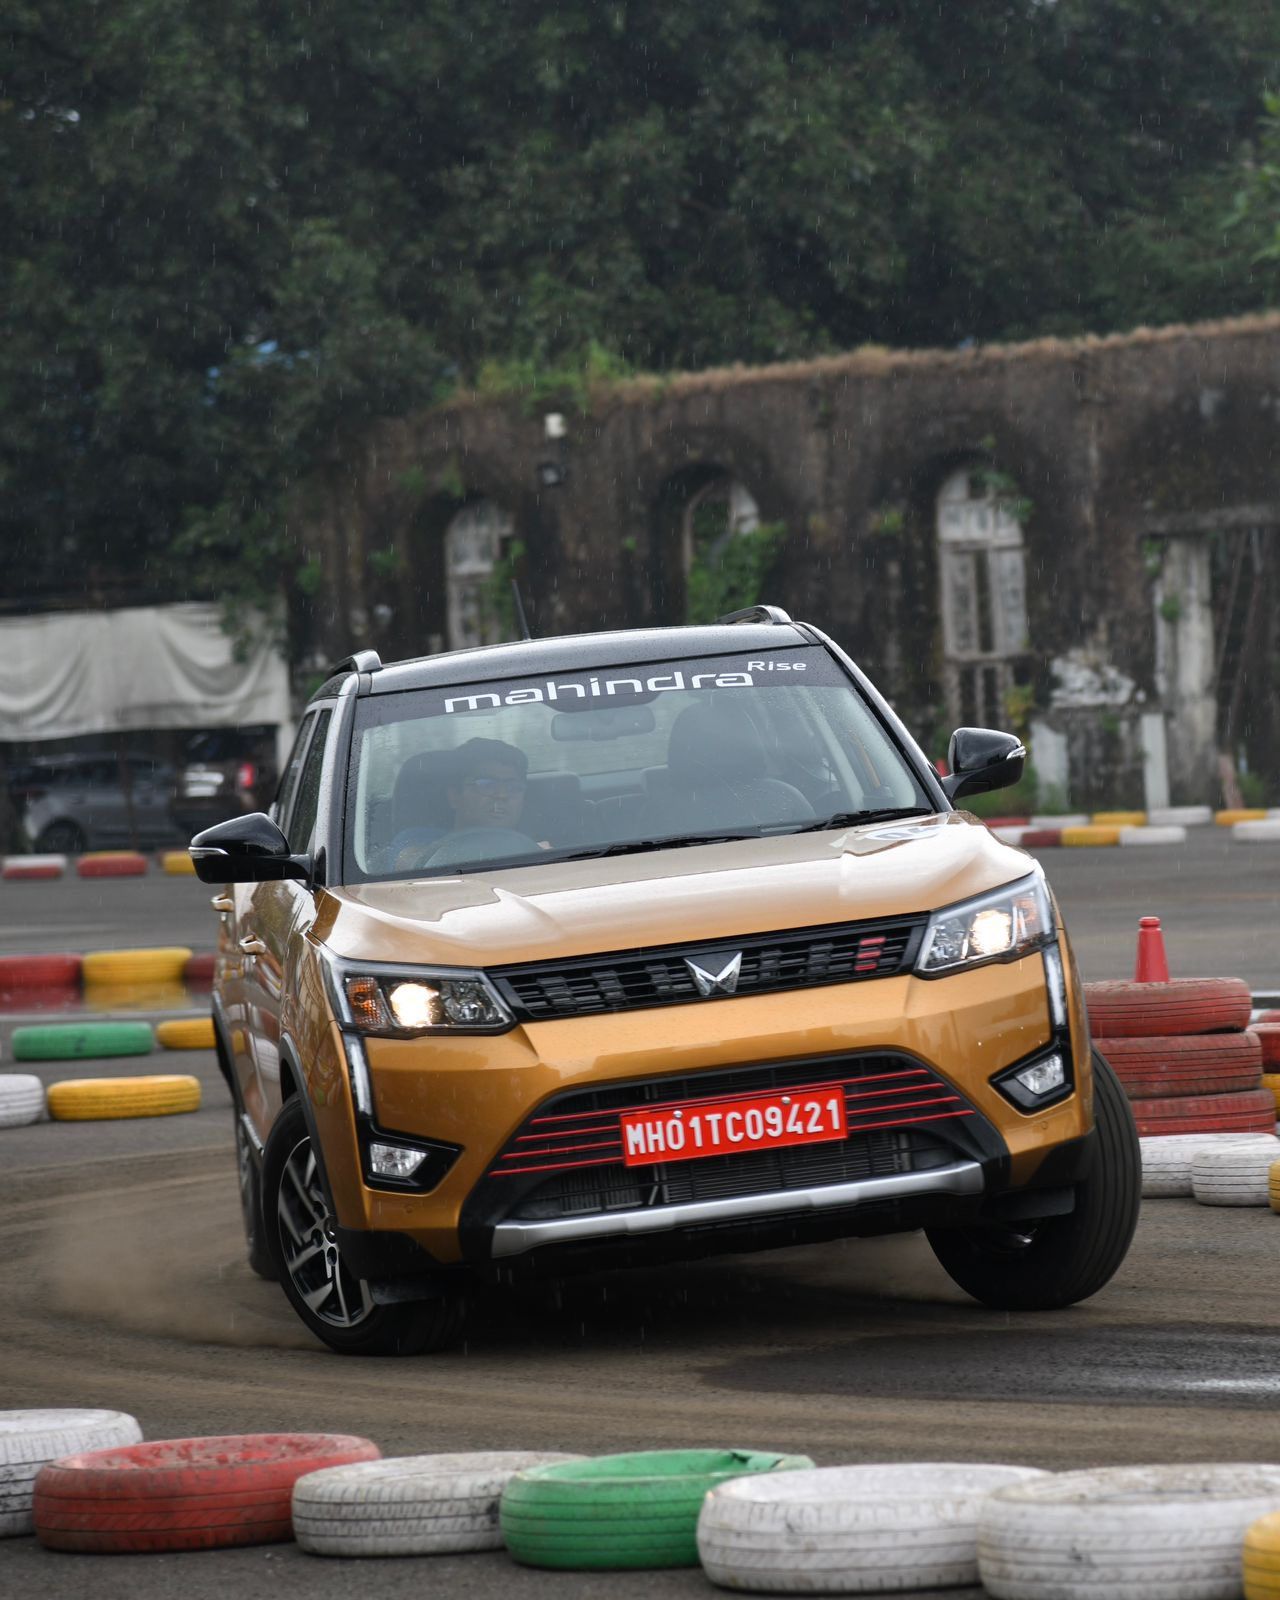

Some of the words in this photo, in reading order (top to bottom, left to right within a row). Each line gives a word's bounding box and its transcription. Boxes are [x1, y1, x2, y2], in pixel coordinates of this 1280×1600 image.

[445, 671, 754, 713] mahindra
[747, 661, 807, 672] Rise
[625, 1099, 840, 1156] MH01TC09421
